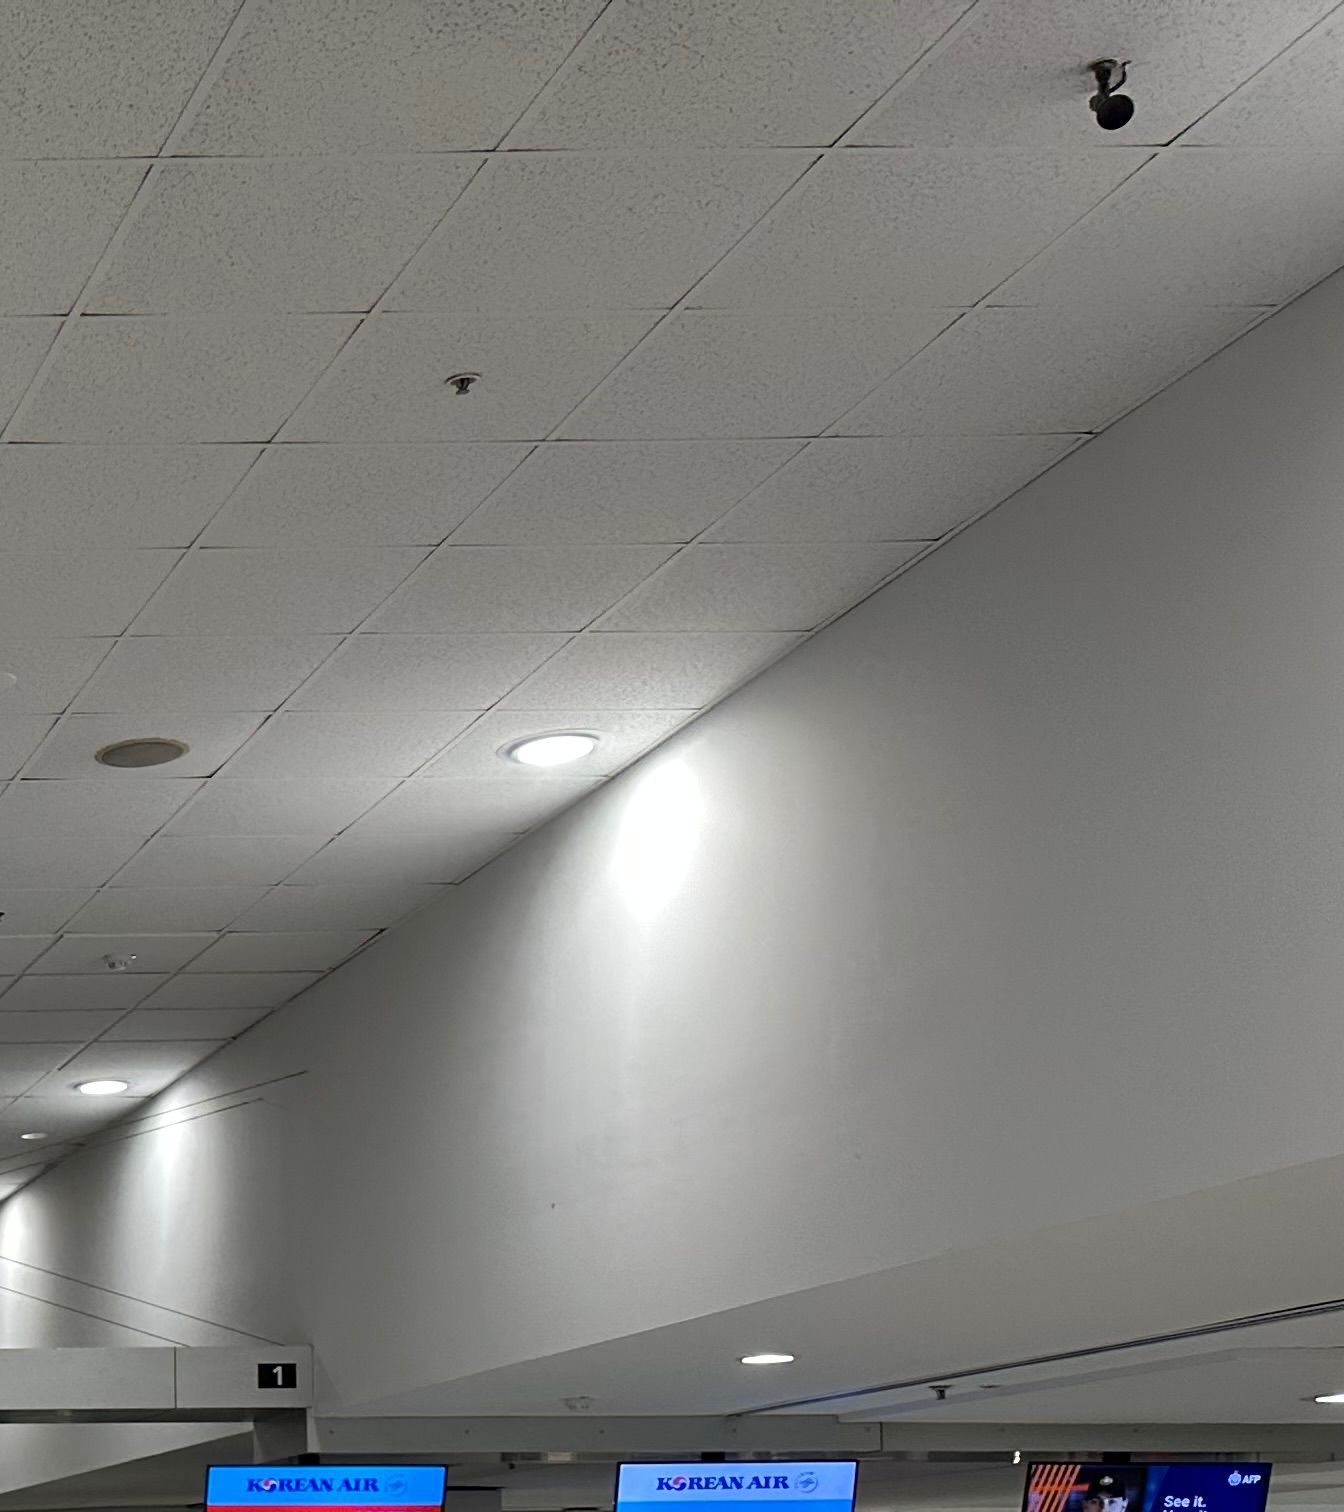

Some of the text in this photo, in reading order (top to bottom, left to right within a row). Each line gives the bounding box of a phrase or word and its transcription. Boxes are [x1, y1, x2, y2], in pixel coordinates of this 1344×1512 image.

[272, 1365, 283, 1386] 1
[246, 1477, 379, 1493] KOREAN AIR
[656, 1475, 744, 1492] KOREAN
[746, 1475, 790, 1490] AIR
[1242, 1474, 1262, 1484] AFP
[1163, 1495, 1207, 1508] See it.
